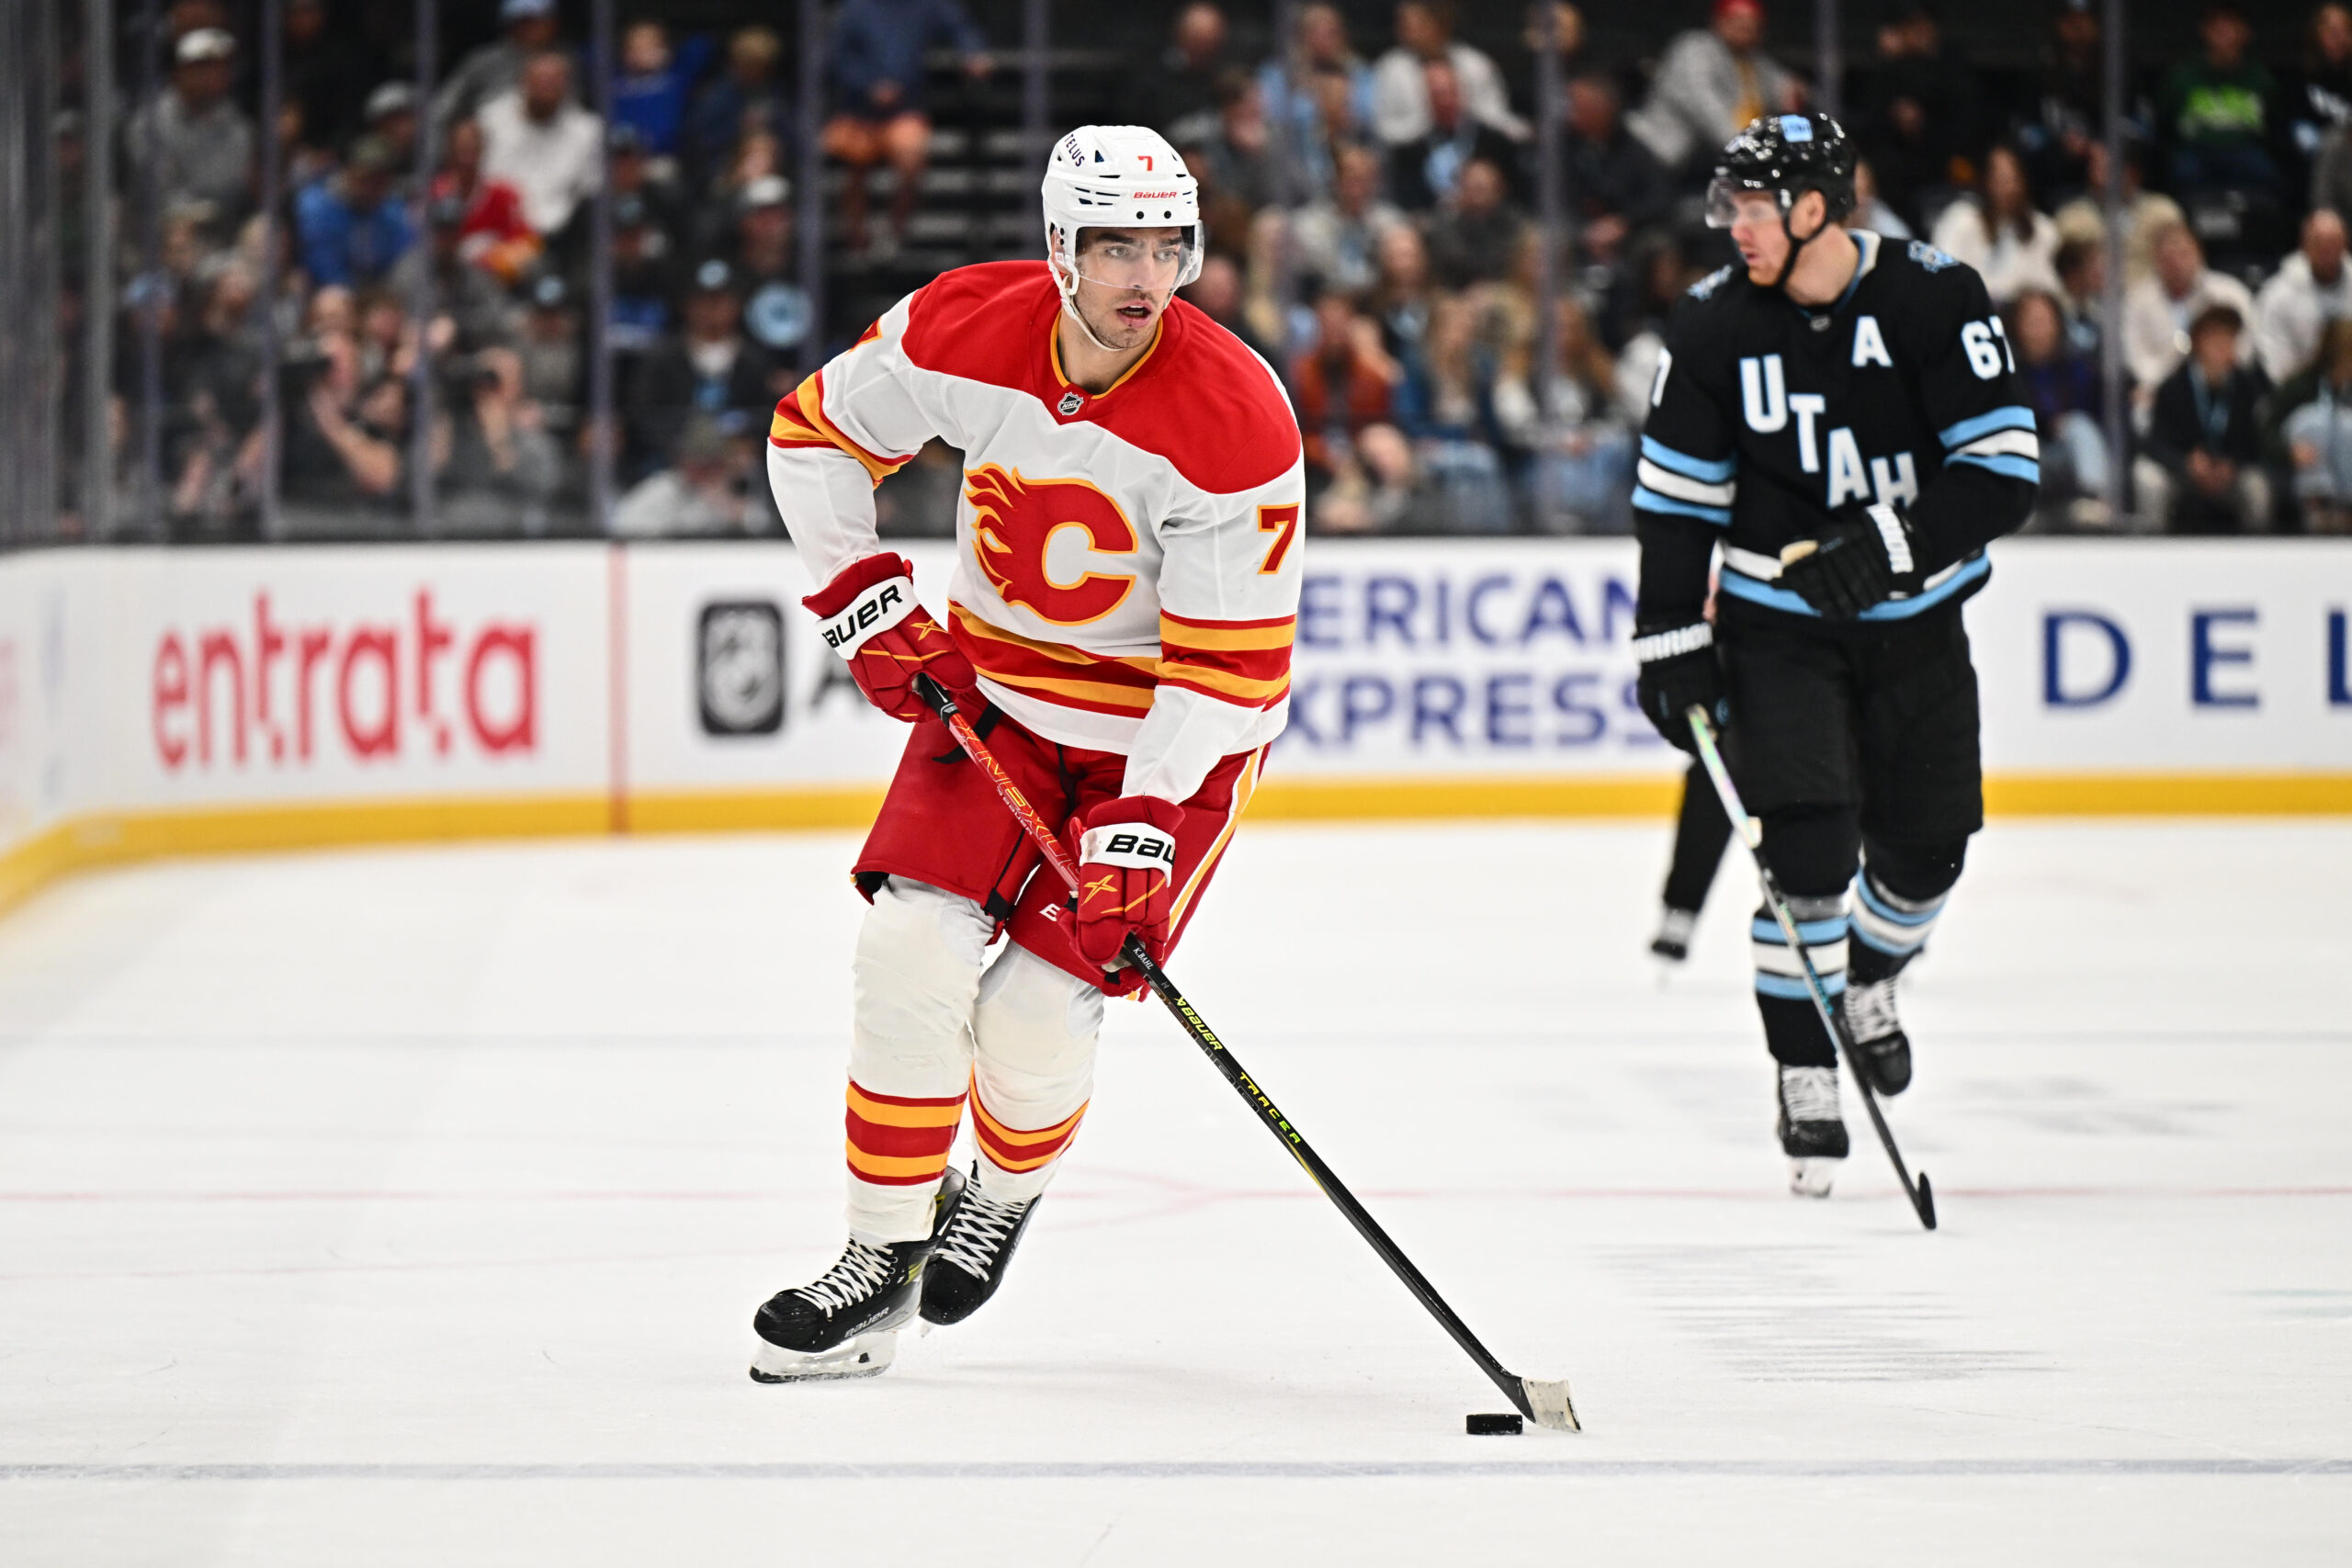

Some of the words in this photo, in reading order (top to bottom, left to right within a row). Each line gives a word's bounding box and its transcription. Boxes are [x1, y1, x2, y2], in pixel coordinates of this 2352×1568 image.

[1064, 133, 1085, 167] TELUS
[1137, 155, 1153, 172] 7
[1851, 315, 1893, 367] A
[1739, 353, 1919, 509] UTAH
[1257, 502, 1301, 575] 7
[1298, 576, 1638, 645] ERICAN
[153, 585, 537, 769] entrata
[1133, 947, 1154, 970] K.BAHL
[1239, 1071, 1301, 1145] TRACER
